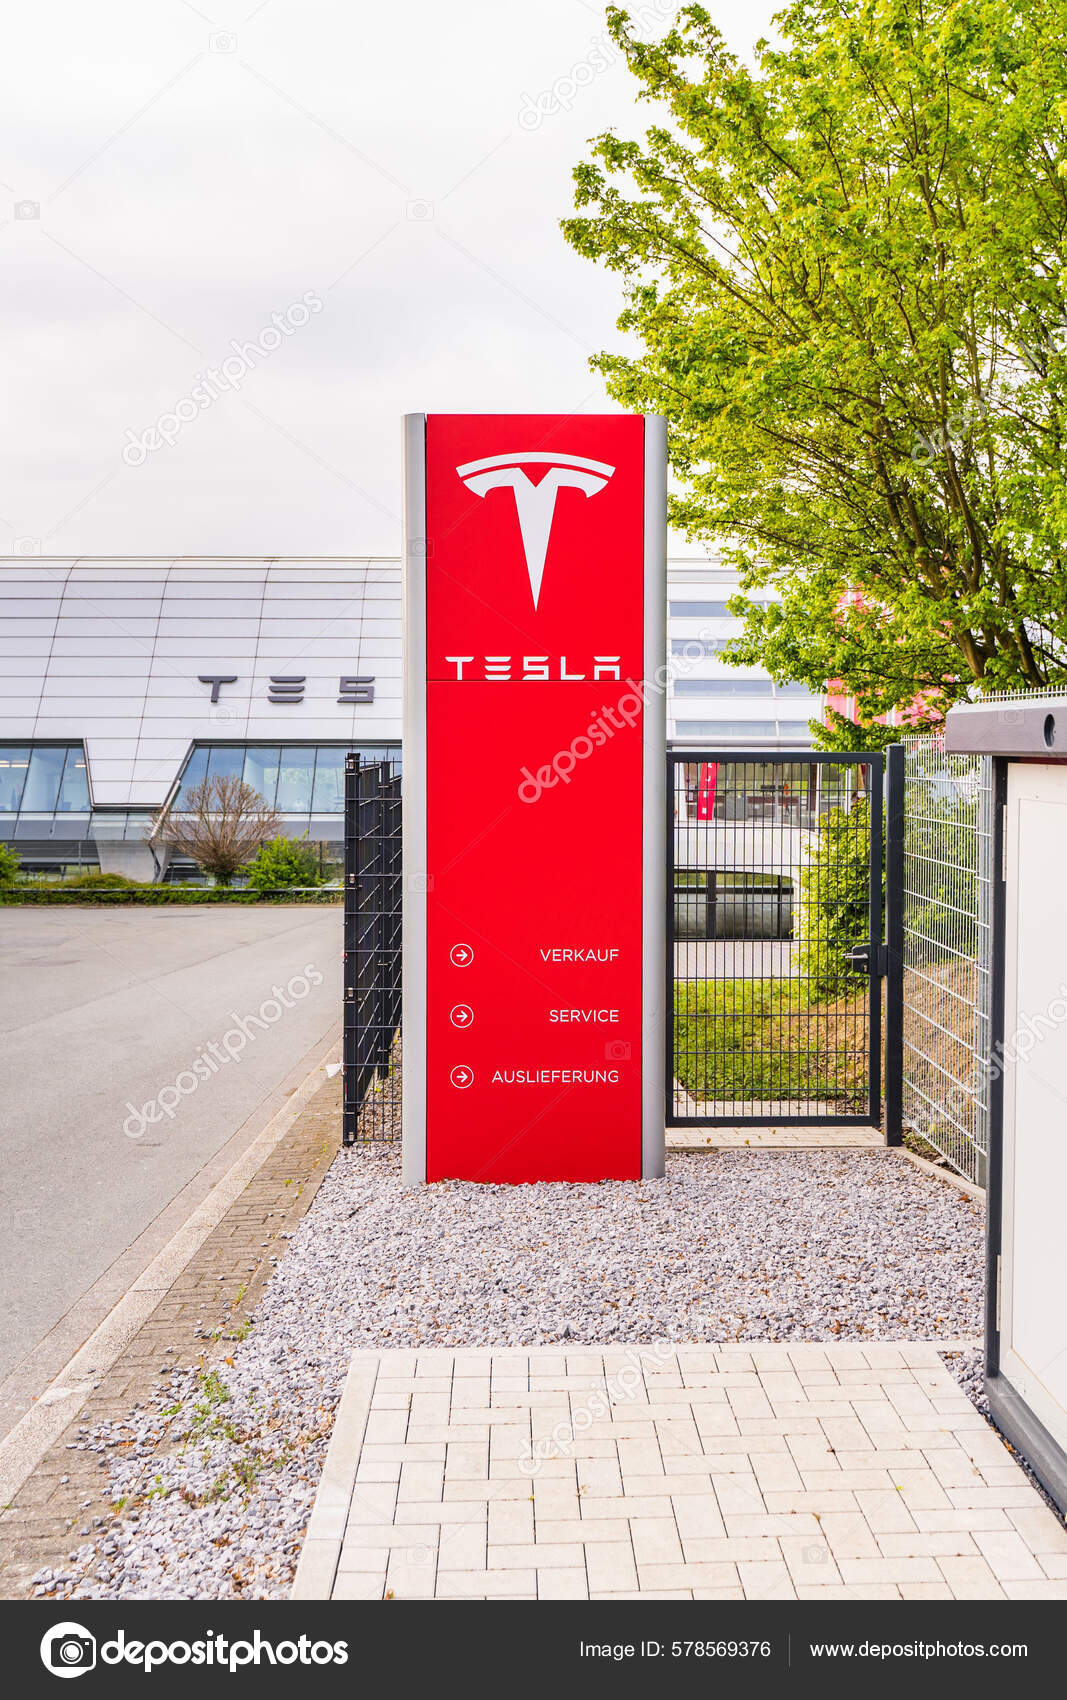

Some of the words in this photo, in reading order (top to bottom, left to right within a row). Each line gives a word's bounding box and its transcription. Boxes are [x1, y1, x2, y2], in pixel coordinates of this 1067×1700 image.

[445, 656, 620, 680] TESLA
[540, 949, 619, 962] VERKAUF
[549, 1009, 619, 1023] SERVICE
[491, 1070, 619, 1083] AUSLIEFERUNG
